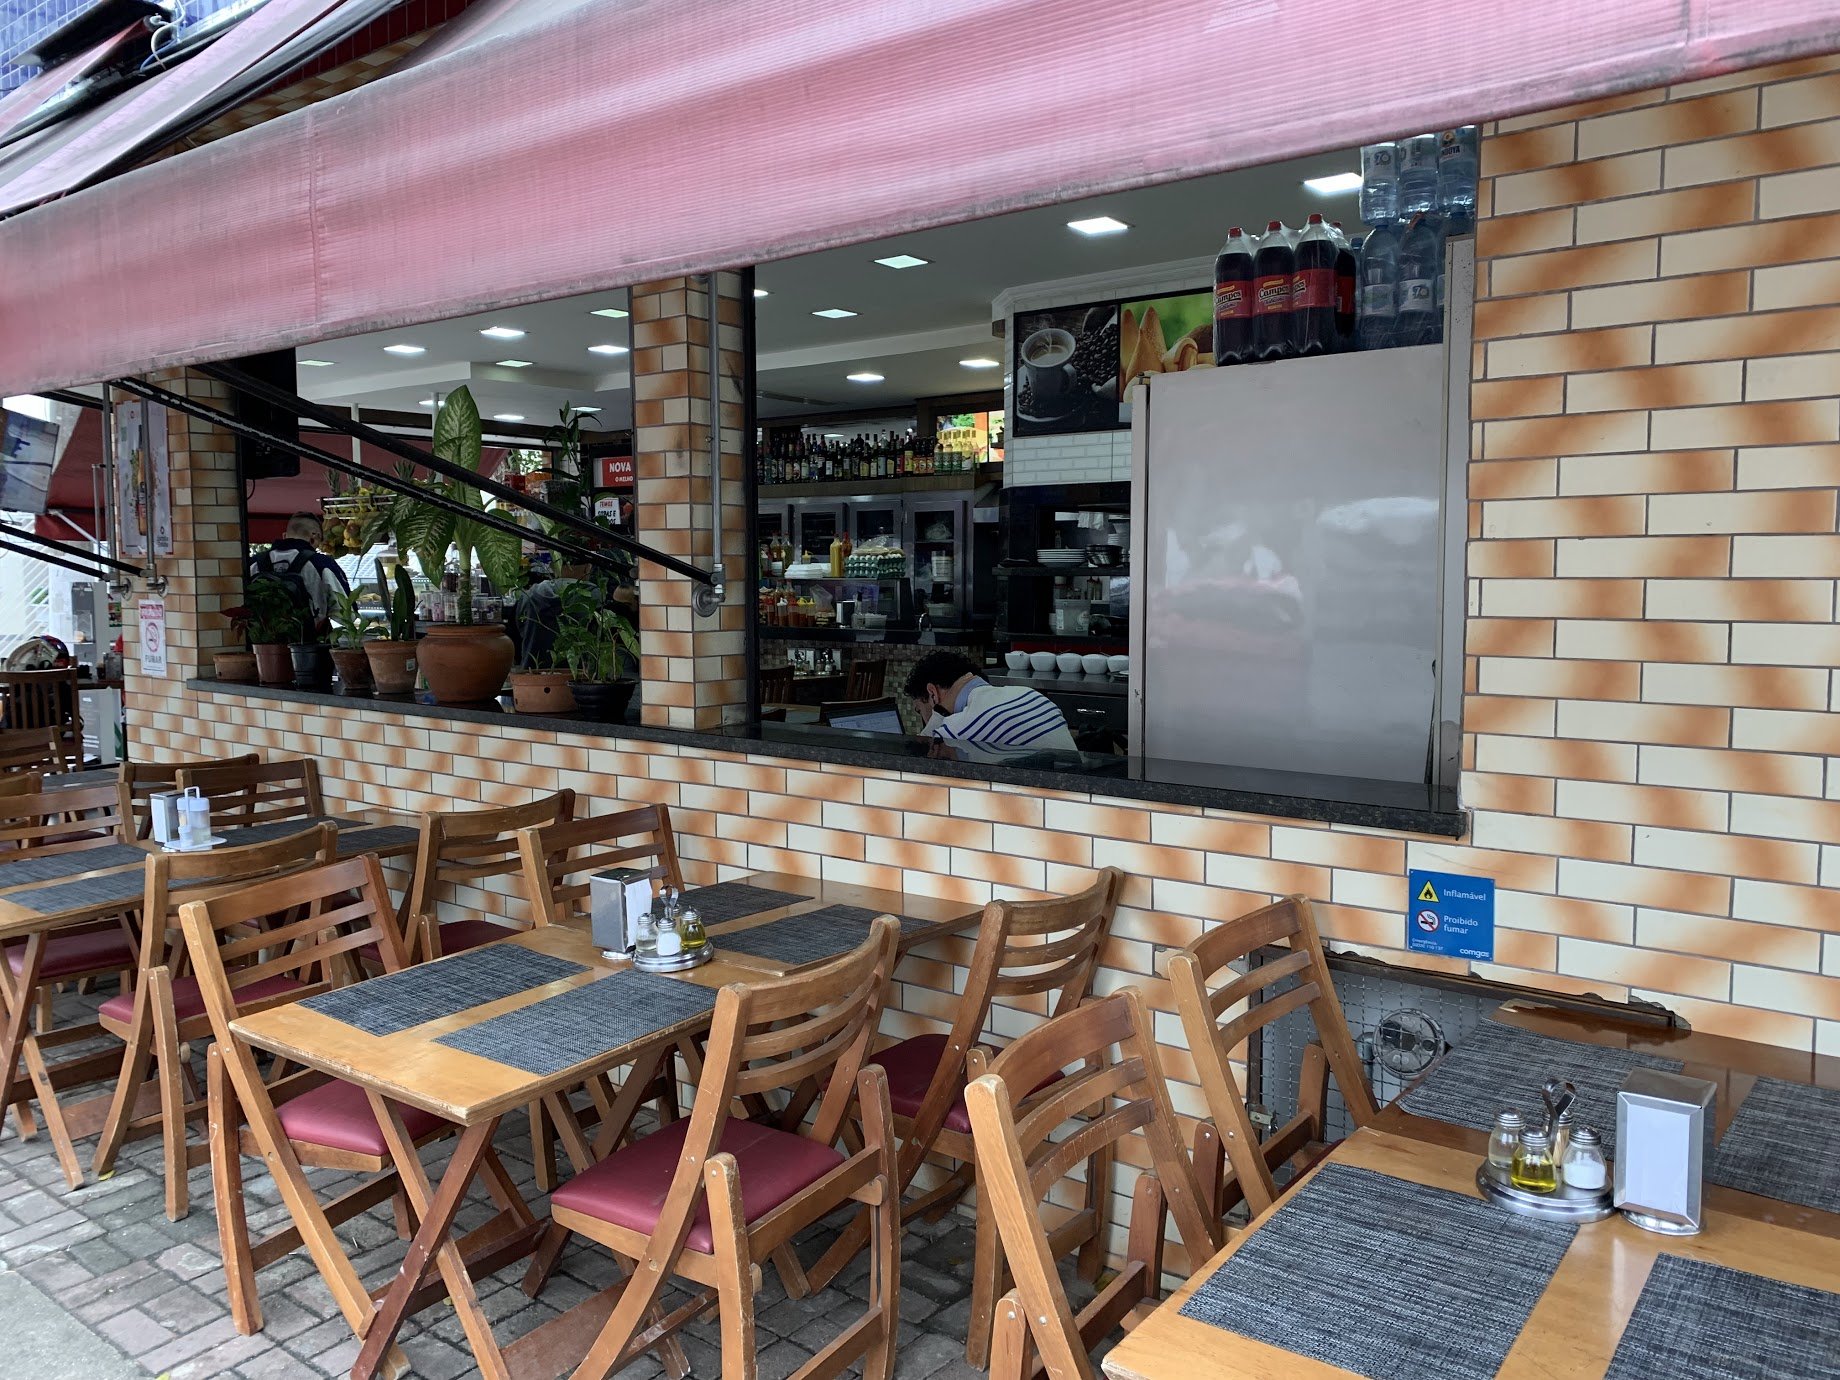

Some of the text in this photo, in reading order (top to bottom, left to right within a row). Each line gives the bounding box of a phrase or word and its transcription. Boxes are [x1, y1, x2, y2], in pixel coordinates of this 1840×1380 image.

[609, 462, 631, 472] NOVA
[1444, 889, 1486, 900] Inflamável
[1444, 916, 1478, 926] Proibido
[1444, 924, 1468, 934] fumar
